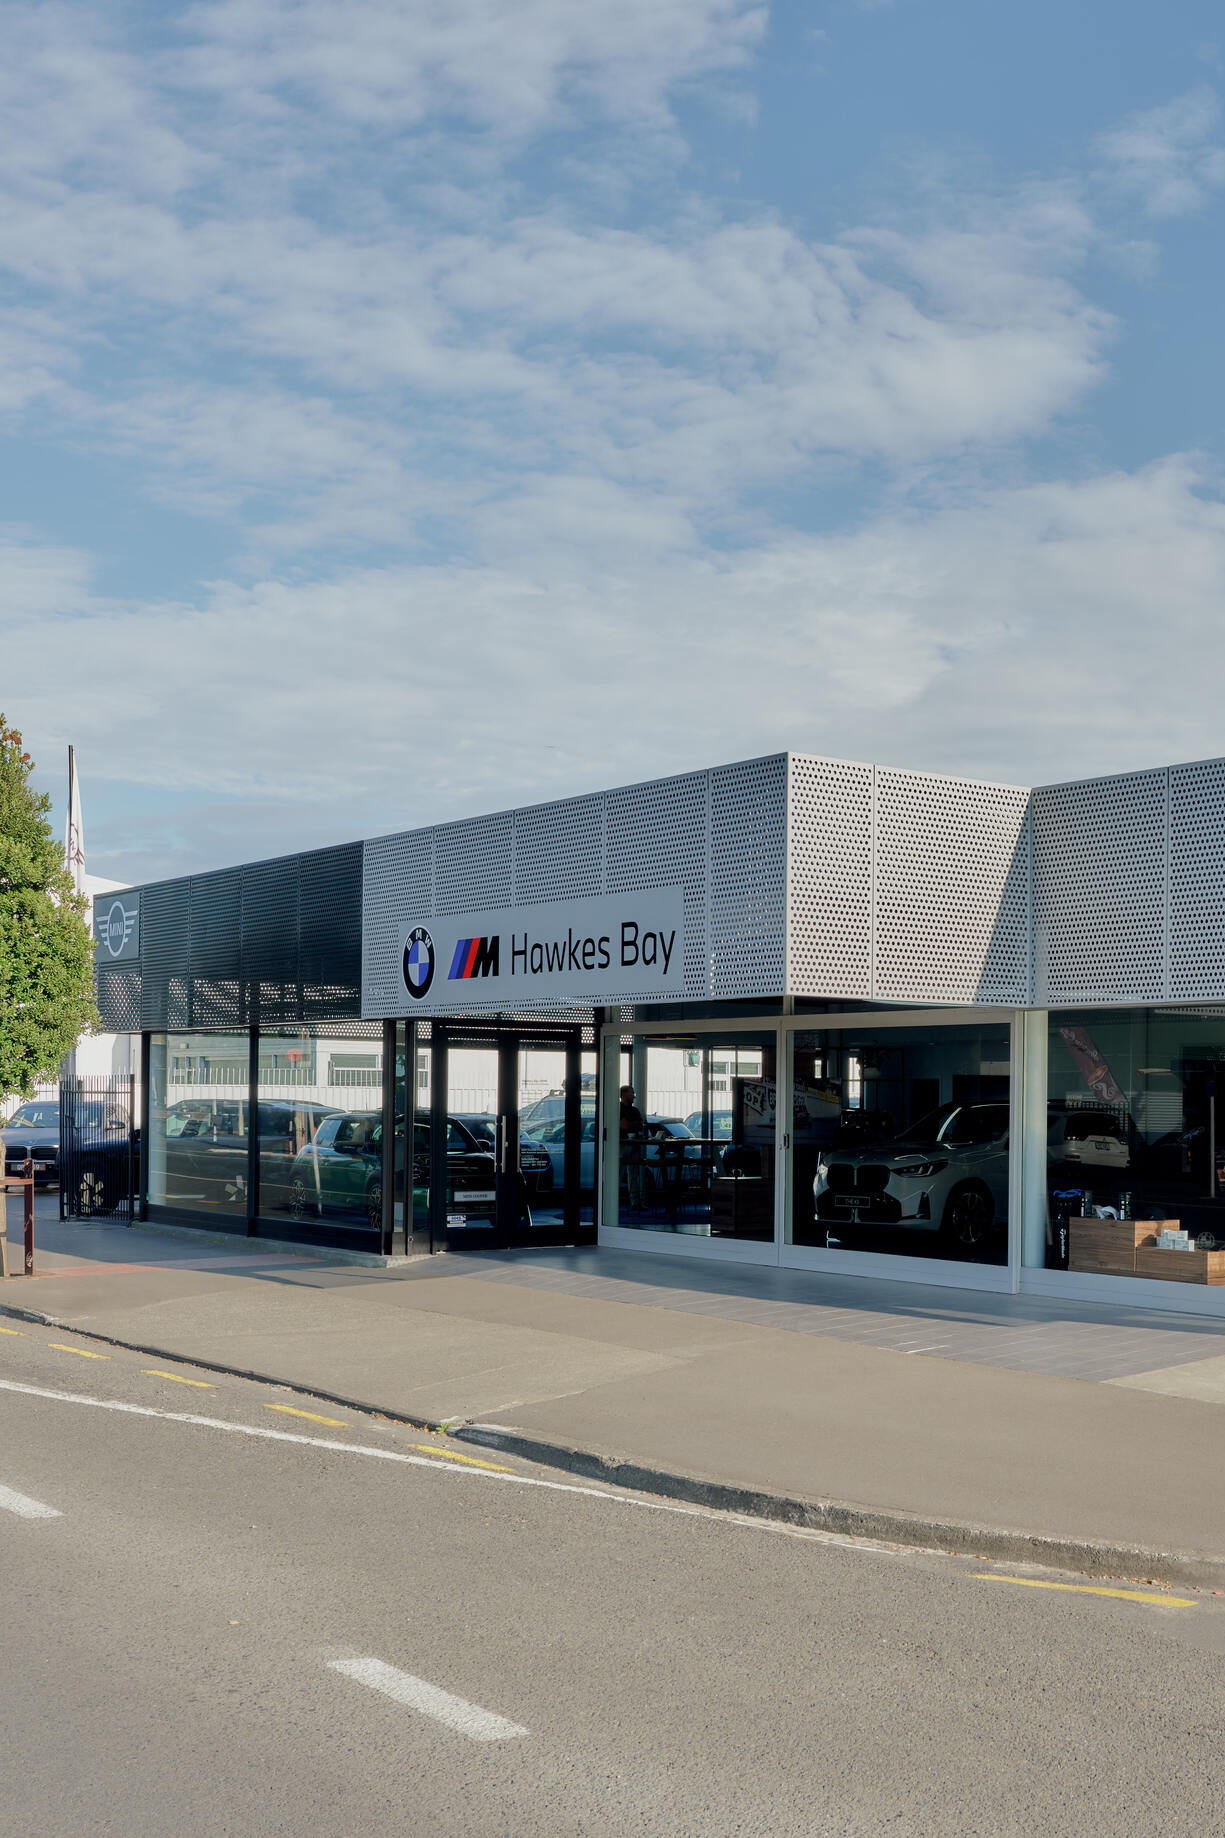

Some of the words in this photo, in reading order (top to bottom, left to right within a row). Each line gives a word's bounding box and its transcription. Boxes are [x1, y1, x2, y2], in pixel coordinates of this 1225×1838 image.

[109, 921, 124, 937] MINI
[405, 928, 432, 951] BMW
[471, 935, 500, 978] M
[511, 927, 611, 975] Hawkes
[620, 921, 676, 975] Bay
